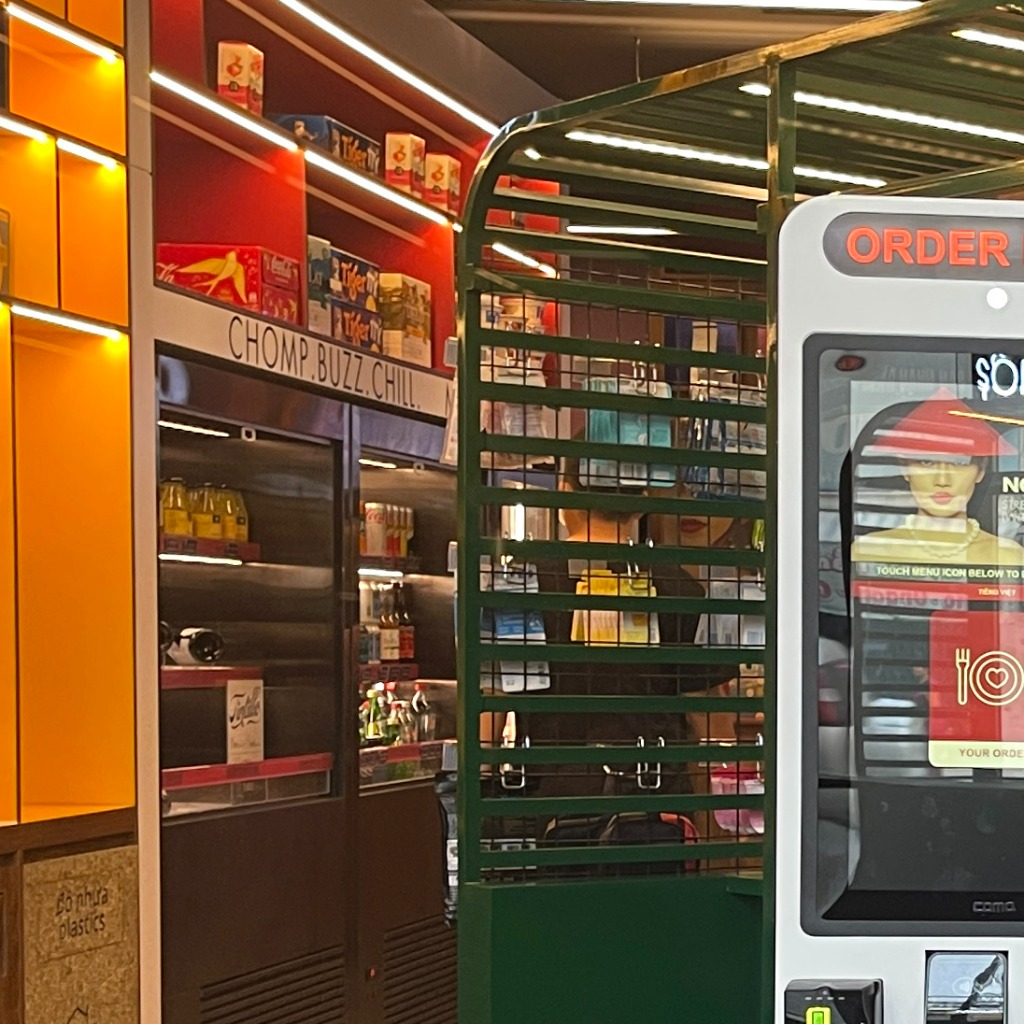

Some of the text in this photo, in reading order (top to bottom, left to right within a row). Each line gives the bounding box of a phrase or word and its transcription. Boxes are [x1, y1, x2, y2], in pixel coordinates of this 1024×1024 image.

[846, 227, 1010, 266] ORDER
[877, 566, 910, 576] TOUCH
[912, 567, 940, 577] MENU
[942, 568, 967, 577] ICON
[968, 569, 1004, 578] BELOW
[1006, 570, 1020, 578] TO
[959, 748, 990, 758] YOUR
